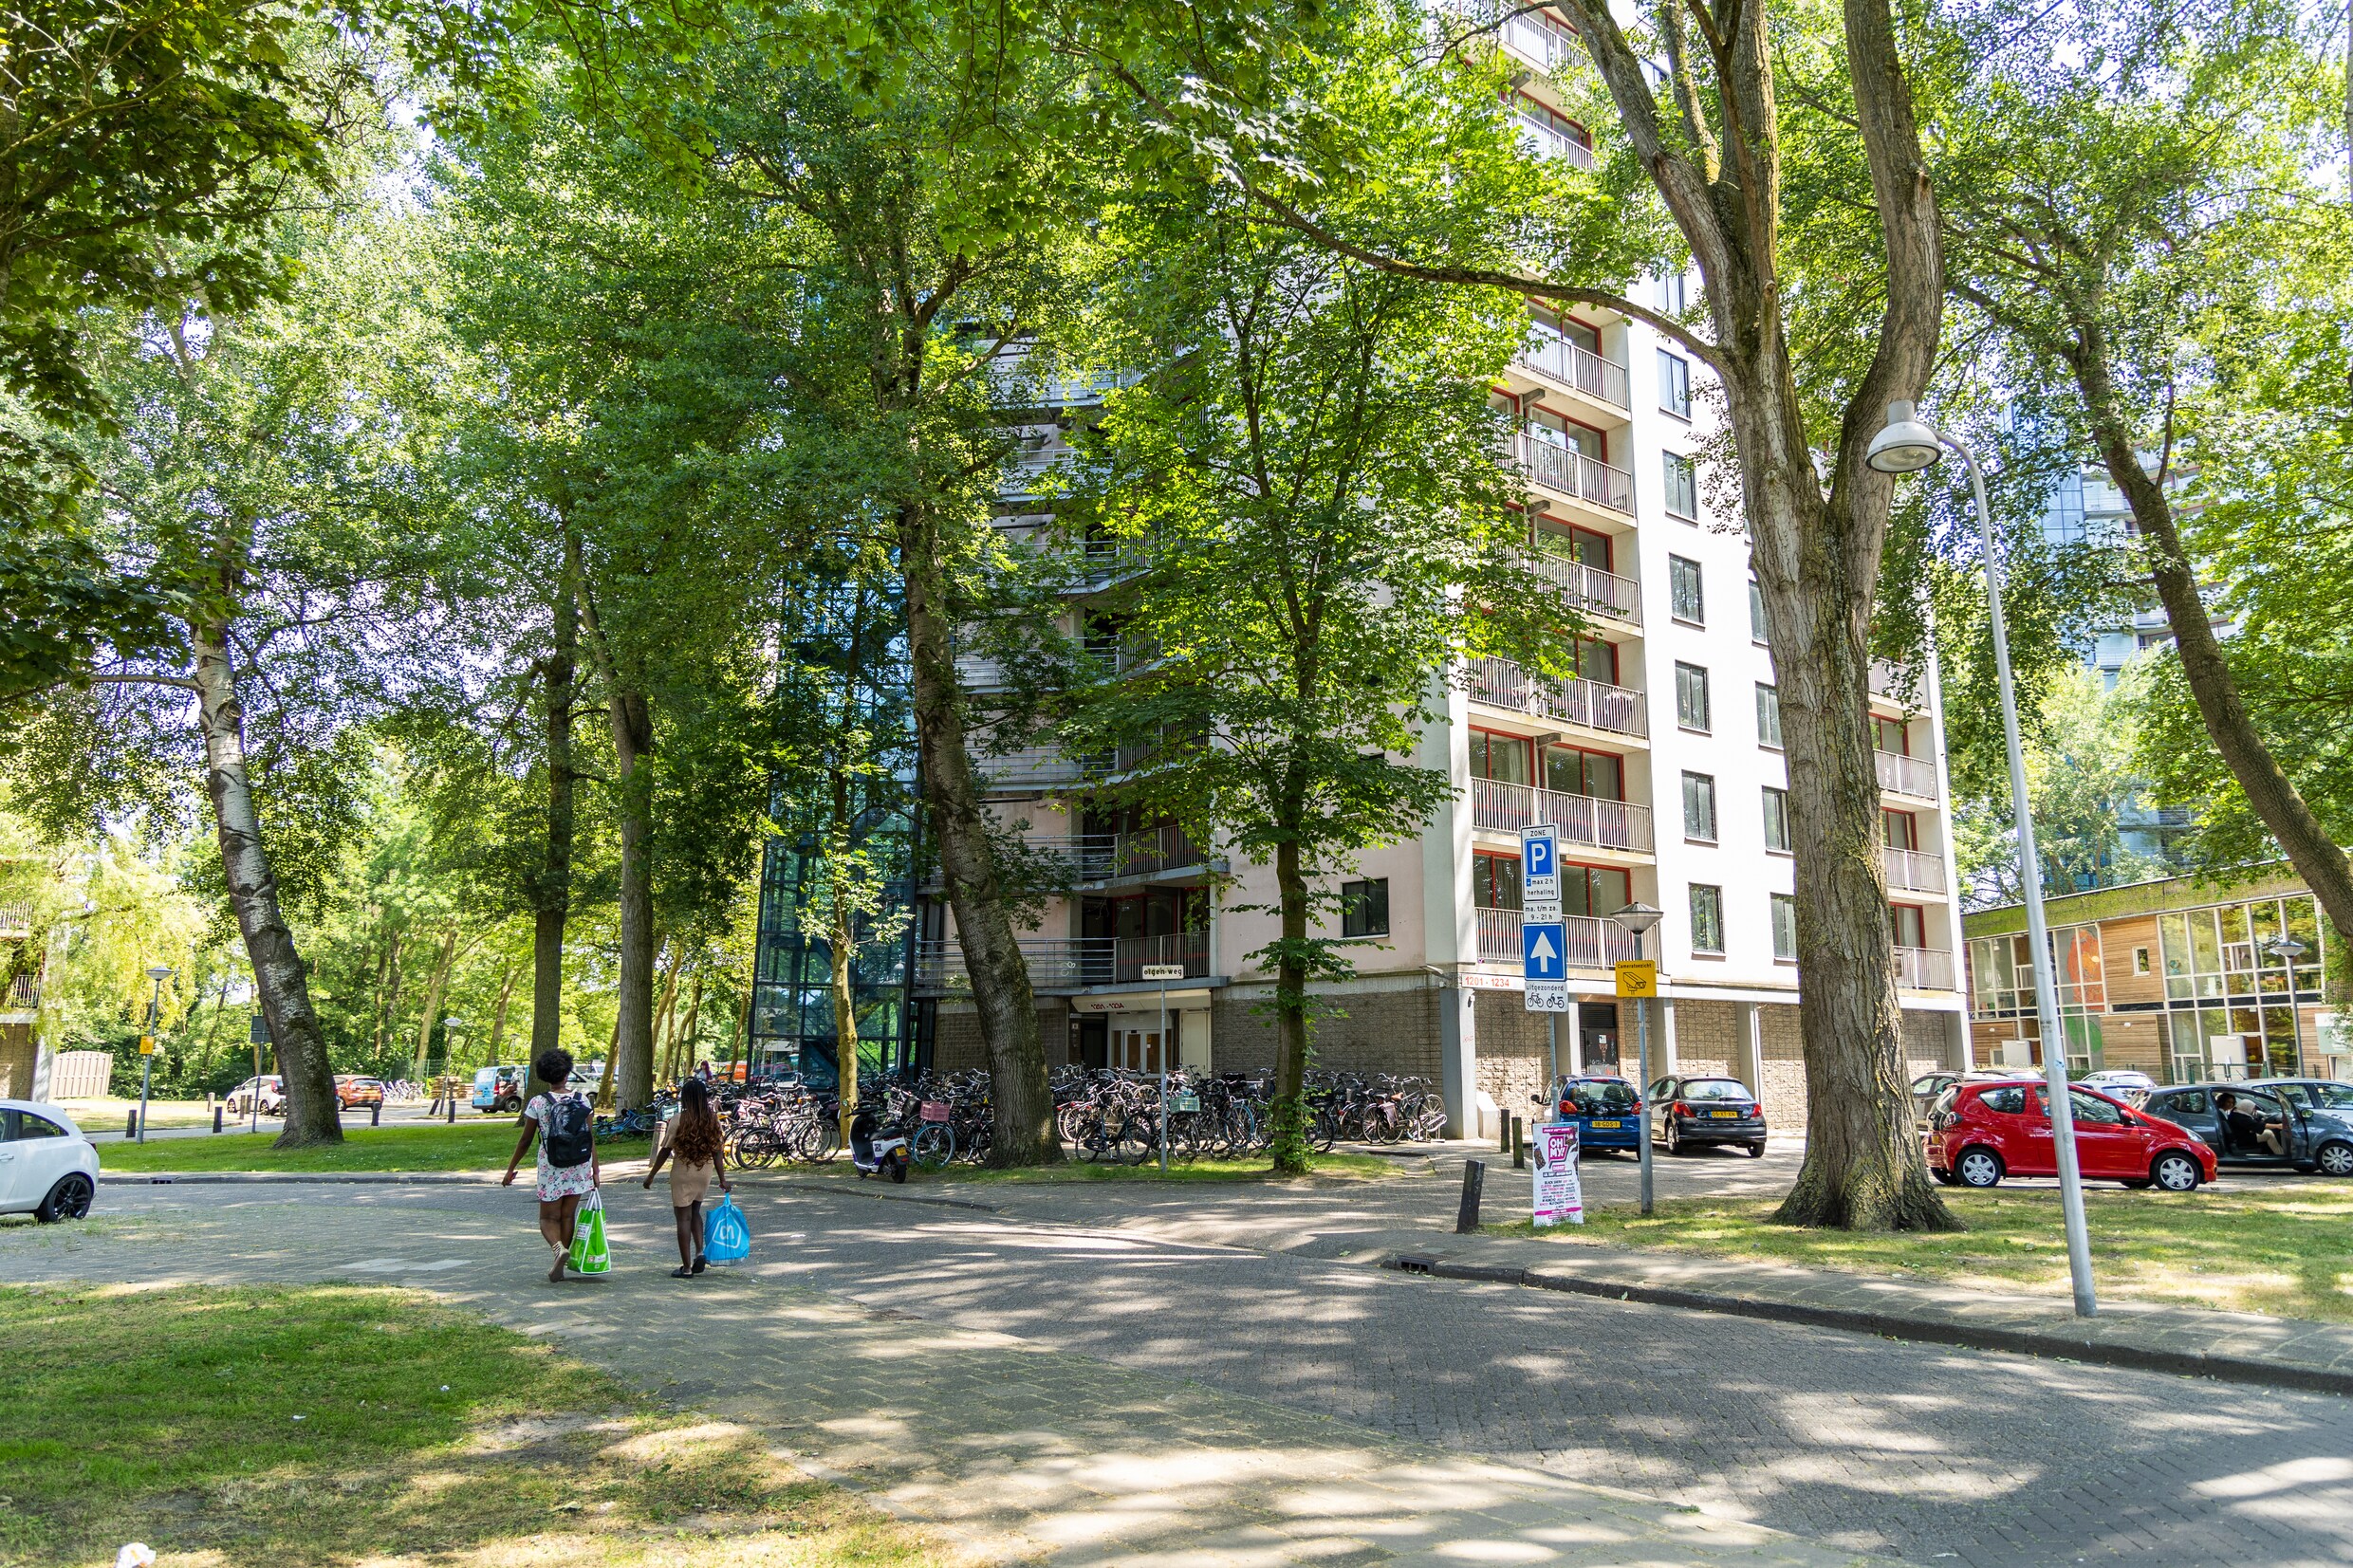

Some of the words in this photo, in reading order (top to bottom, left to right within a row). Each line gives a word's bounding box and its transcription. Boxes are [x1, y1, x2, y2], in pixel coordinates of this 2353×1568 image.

[1530, 842, 1547, 873] P
[1527, 888, 1555, 896] herhaling
[1167, 968, 1183, 977] weg
[1465, 976, 1484, 987] 1201
[1491, 977, 1510, 987] 1234
[1526, 983, 1565, 992] uitgezonderd
[1549, 1137, 1564, 1149] OH
[1549, 1147, 1566, 1158] MY!
